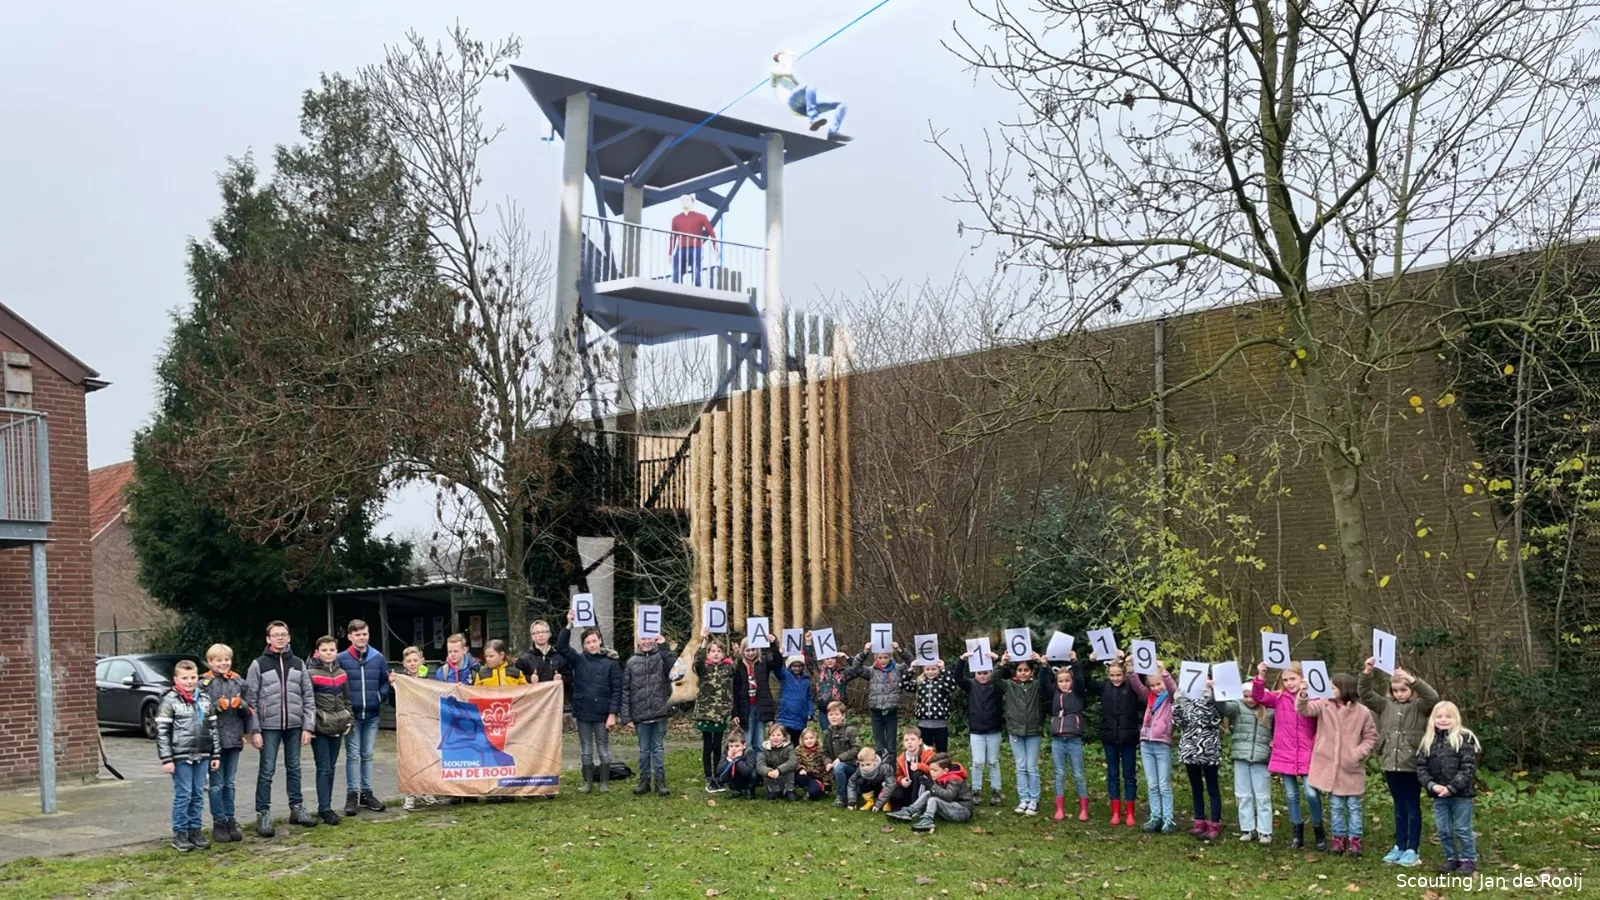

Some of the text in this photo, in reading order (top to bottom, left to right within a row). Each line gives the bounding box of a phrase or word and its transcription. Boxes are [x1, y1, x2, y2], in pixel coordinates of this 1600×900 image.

[576, 600, 891, 655] B E D A N K T
[918, 640, 936, 662] €
[973, 644, 984, 666] 1
[1011, 634, 1027, 657] 6
[1096, 635, 1110, 655] 1
[1136, 646, 1153, 670] 9
[1186, 669, 1203, 694] 7
[1268, 640, 1286, 665] 5
[1308, 668, 1326, 694] 0
[441, 767, 516, 779] JAN DE ROOIJ
